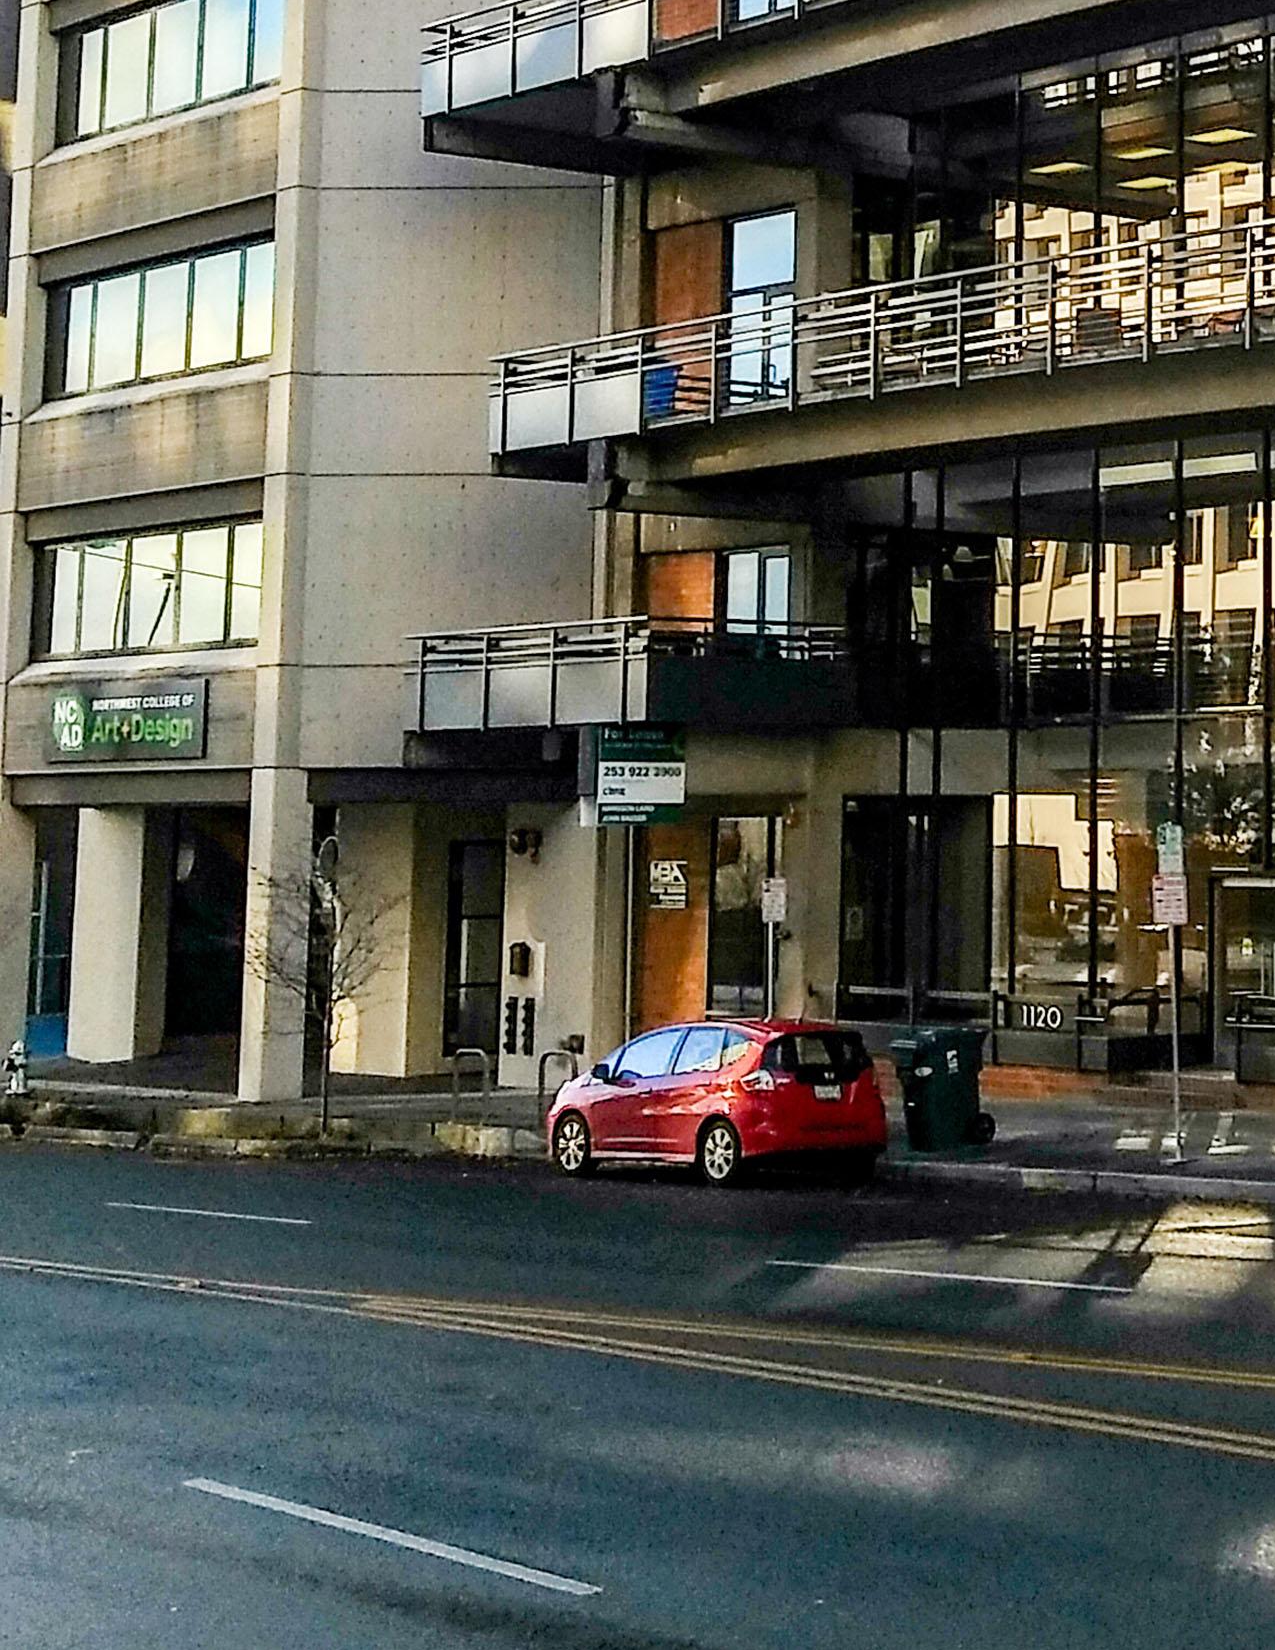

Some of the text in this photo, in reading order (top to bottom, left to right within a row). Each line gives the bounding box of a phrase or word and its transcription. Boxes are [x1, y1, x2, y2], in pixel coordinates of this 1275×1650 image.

[92, 693, 195, 712] NORTHWEST COLLEGE OF
[603, 766, 625, 778] 253
[628, 766, 650, 778] 922
[1022, 1004, 1061, 1029] 1120
